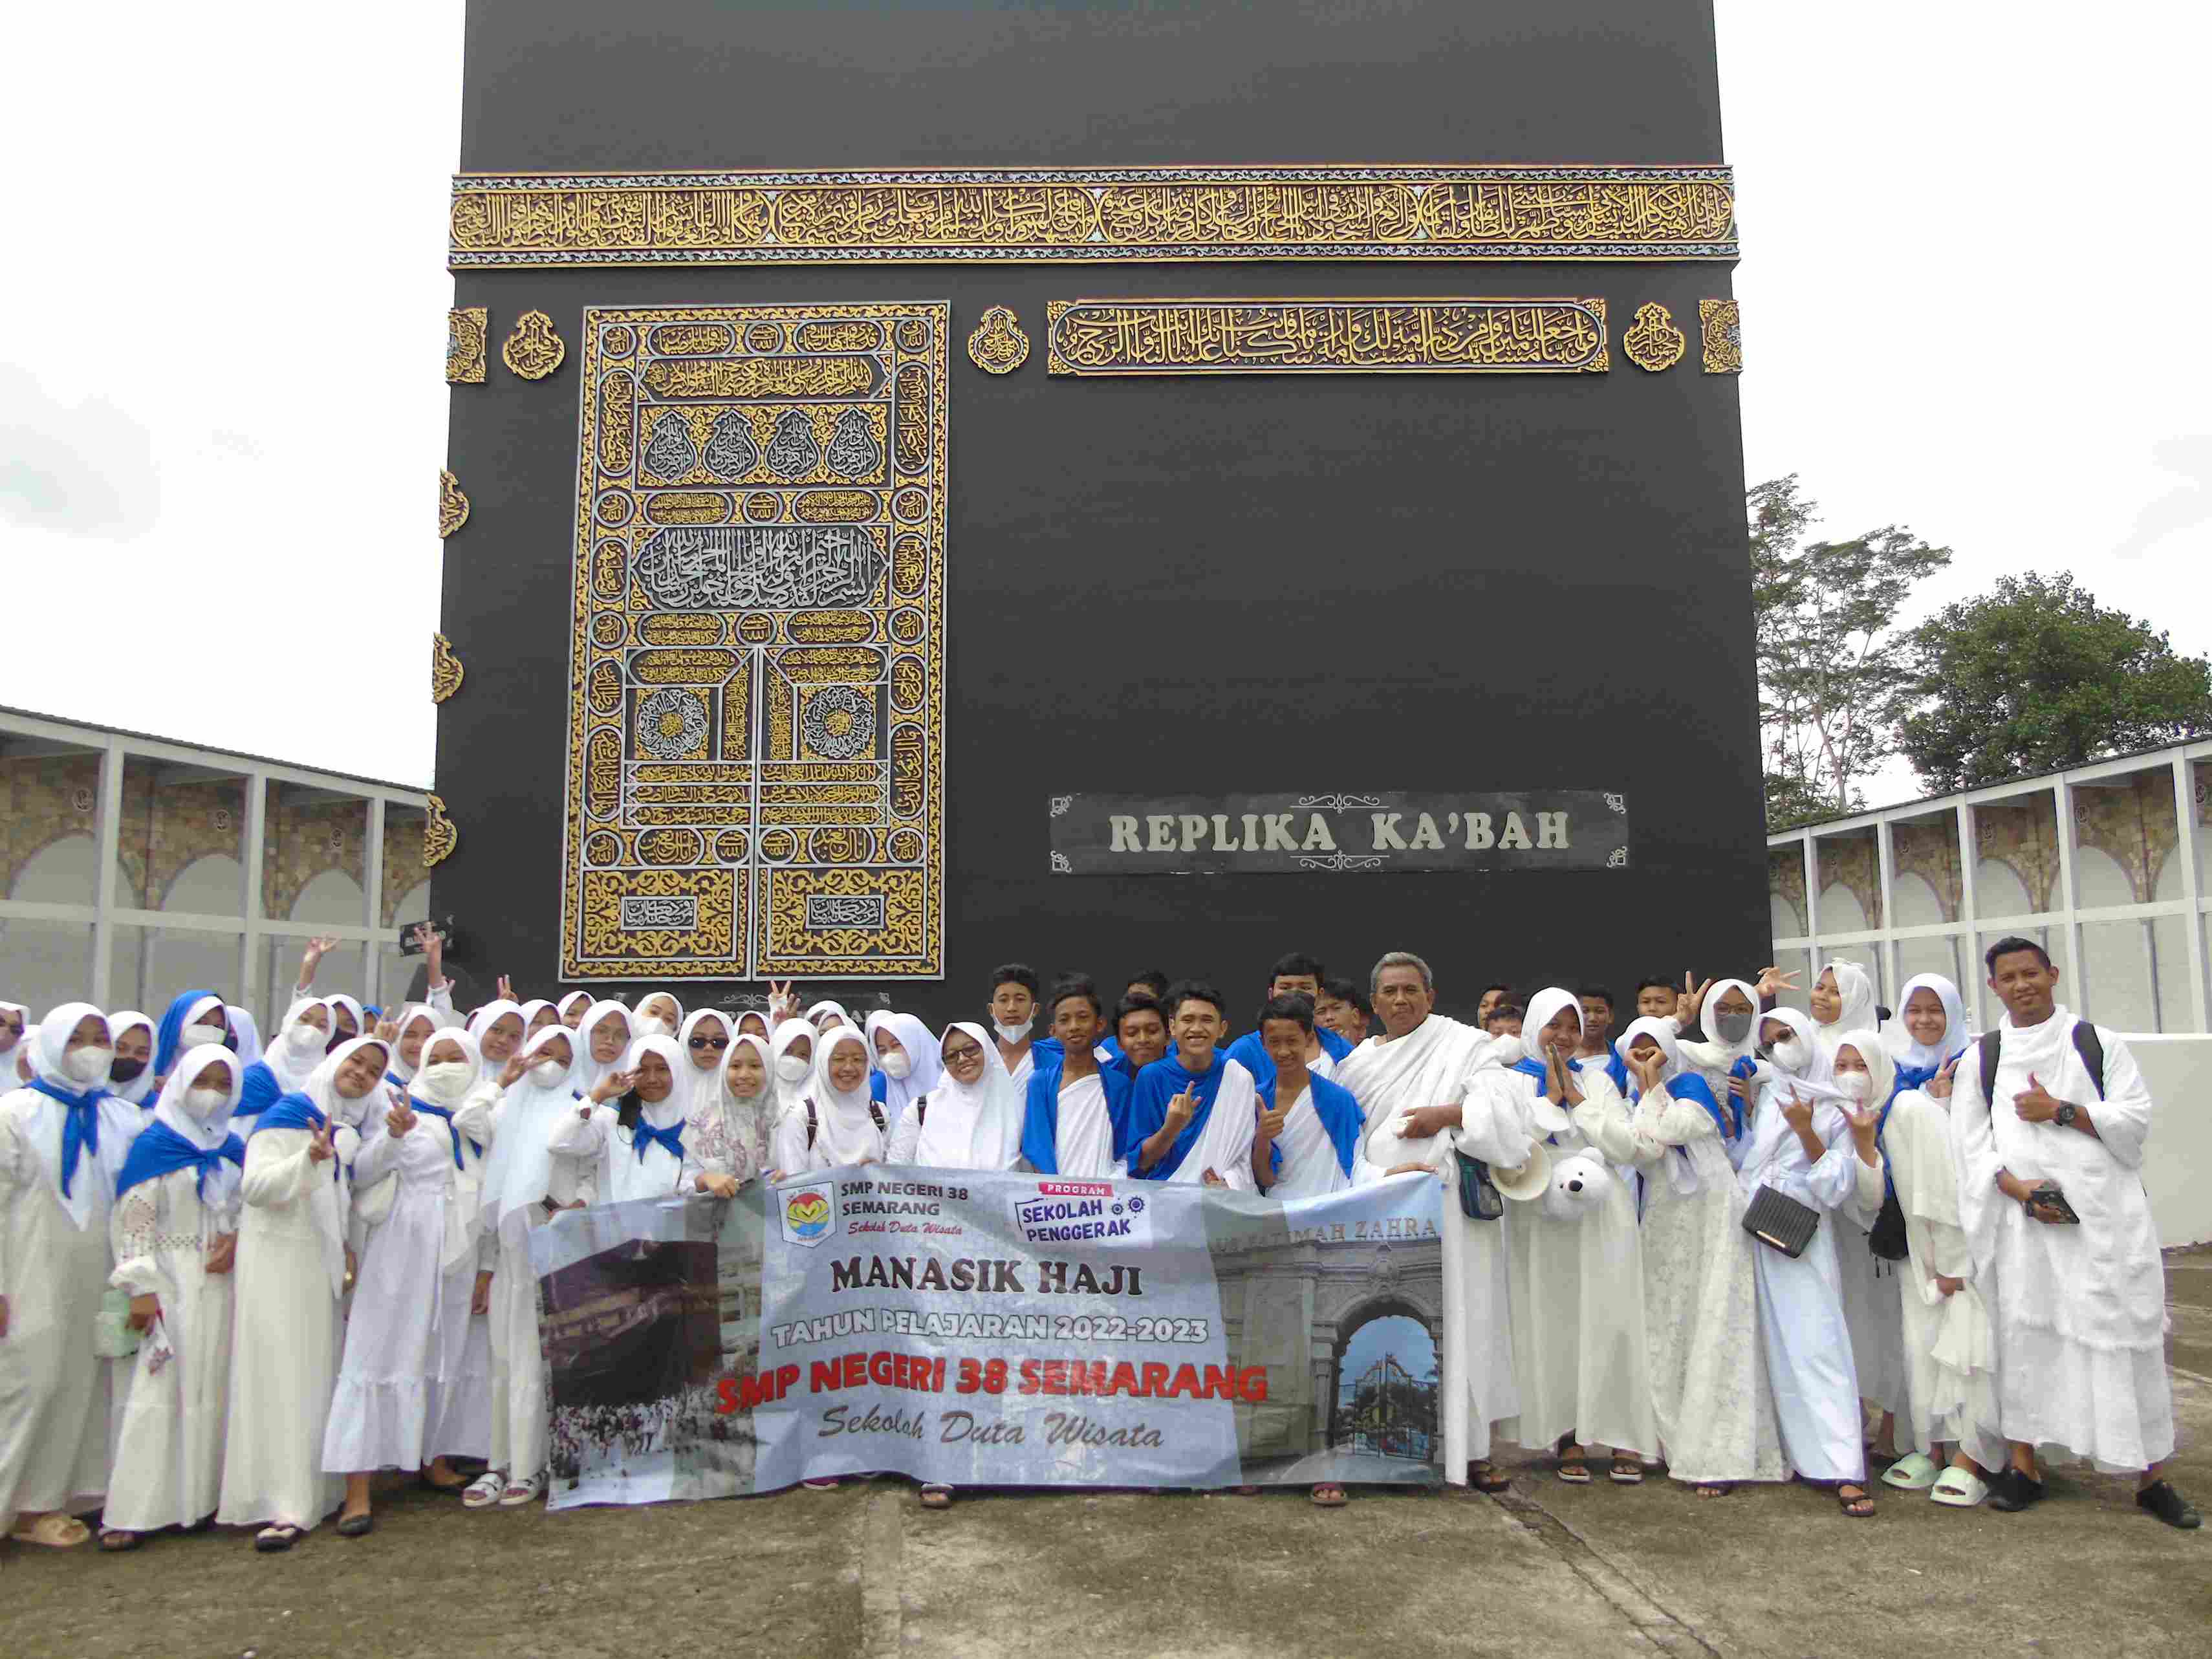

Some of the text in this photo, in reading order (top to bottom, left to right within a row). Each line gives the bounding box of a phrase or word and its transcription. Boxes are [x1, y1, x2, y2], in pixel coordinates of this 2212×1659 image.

[1109, 811, 1570, 852] REPLIKA KA'BAH
[841, 1181, 873, 1197] SMP
[877, 1181, 943, 1197] NEGERI
[947, 1187, 969, 1200] 38
[1047, 1184, 1105, 1195] PROGRAM
[842, 1200, 940, 1216] SEMARANG
[1022, 1198, 1103, 1223] SEKOLAH
[848, 1220, 962, 1235] Sekolah Duta Wisata
[1026, 1219, 1132, 1242] PENGGERAK
[1354, 1217, 1438, 1241] ZAHRA
[830, 1255, 1143, 1296] MANASIK HAJI
[771, 1308, 1208, 1349] TAHUN PELAJARAN 2022-2023
[715, 1350, 1268, 1415] SMP NEGERI 38 SEMARANG
[818, 1404, 1165, 1448] Sekolah Duta Wisata
